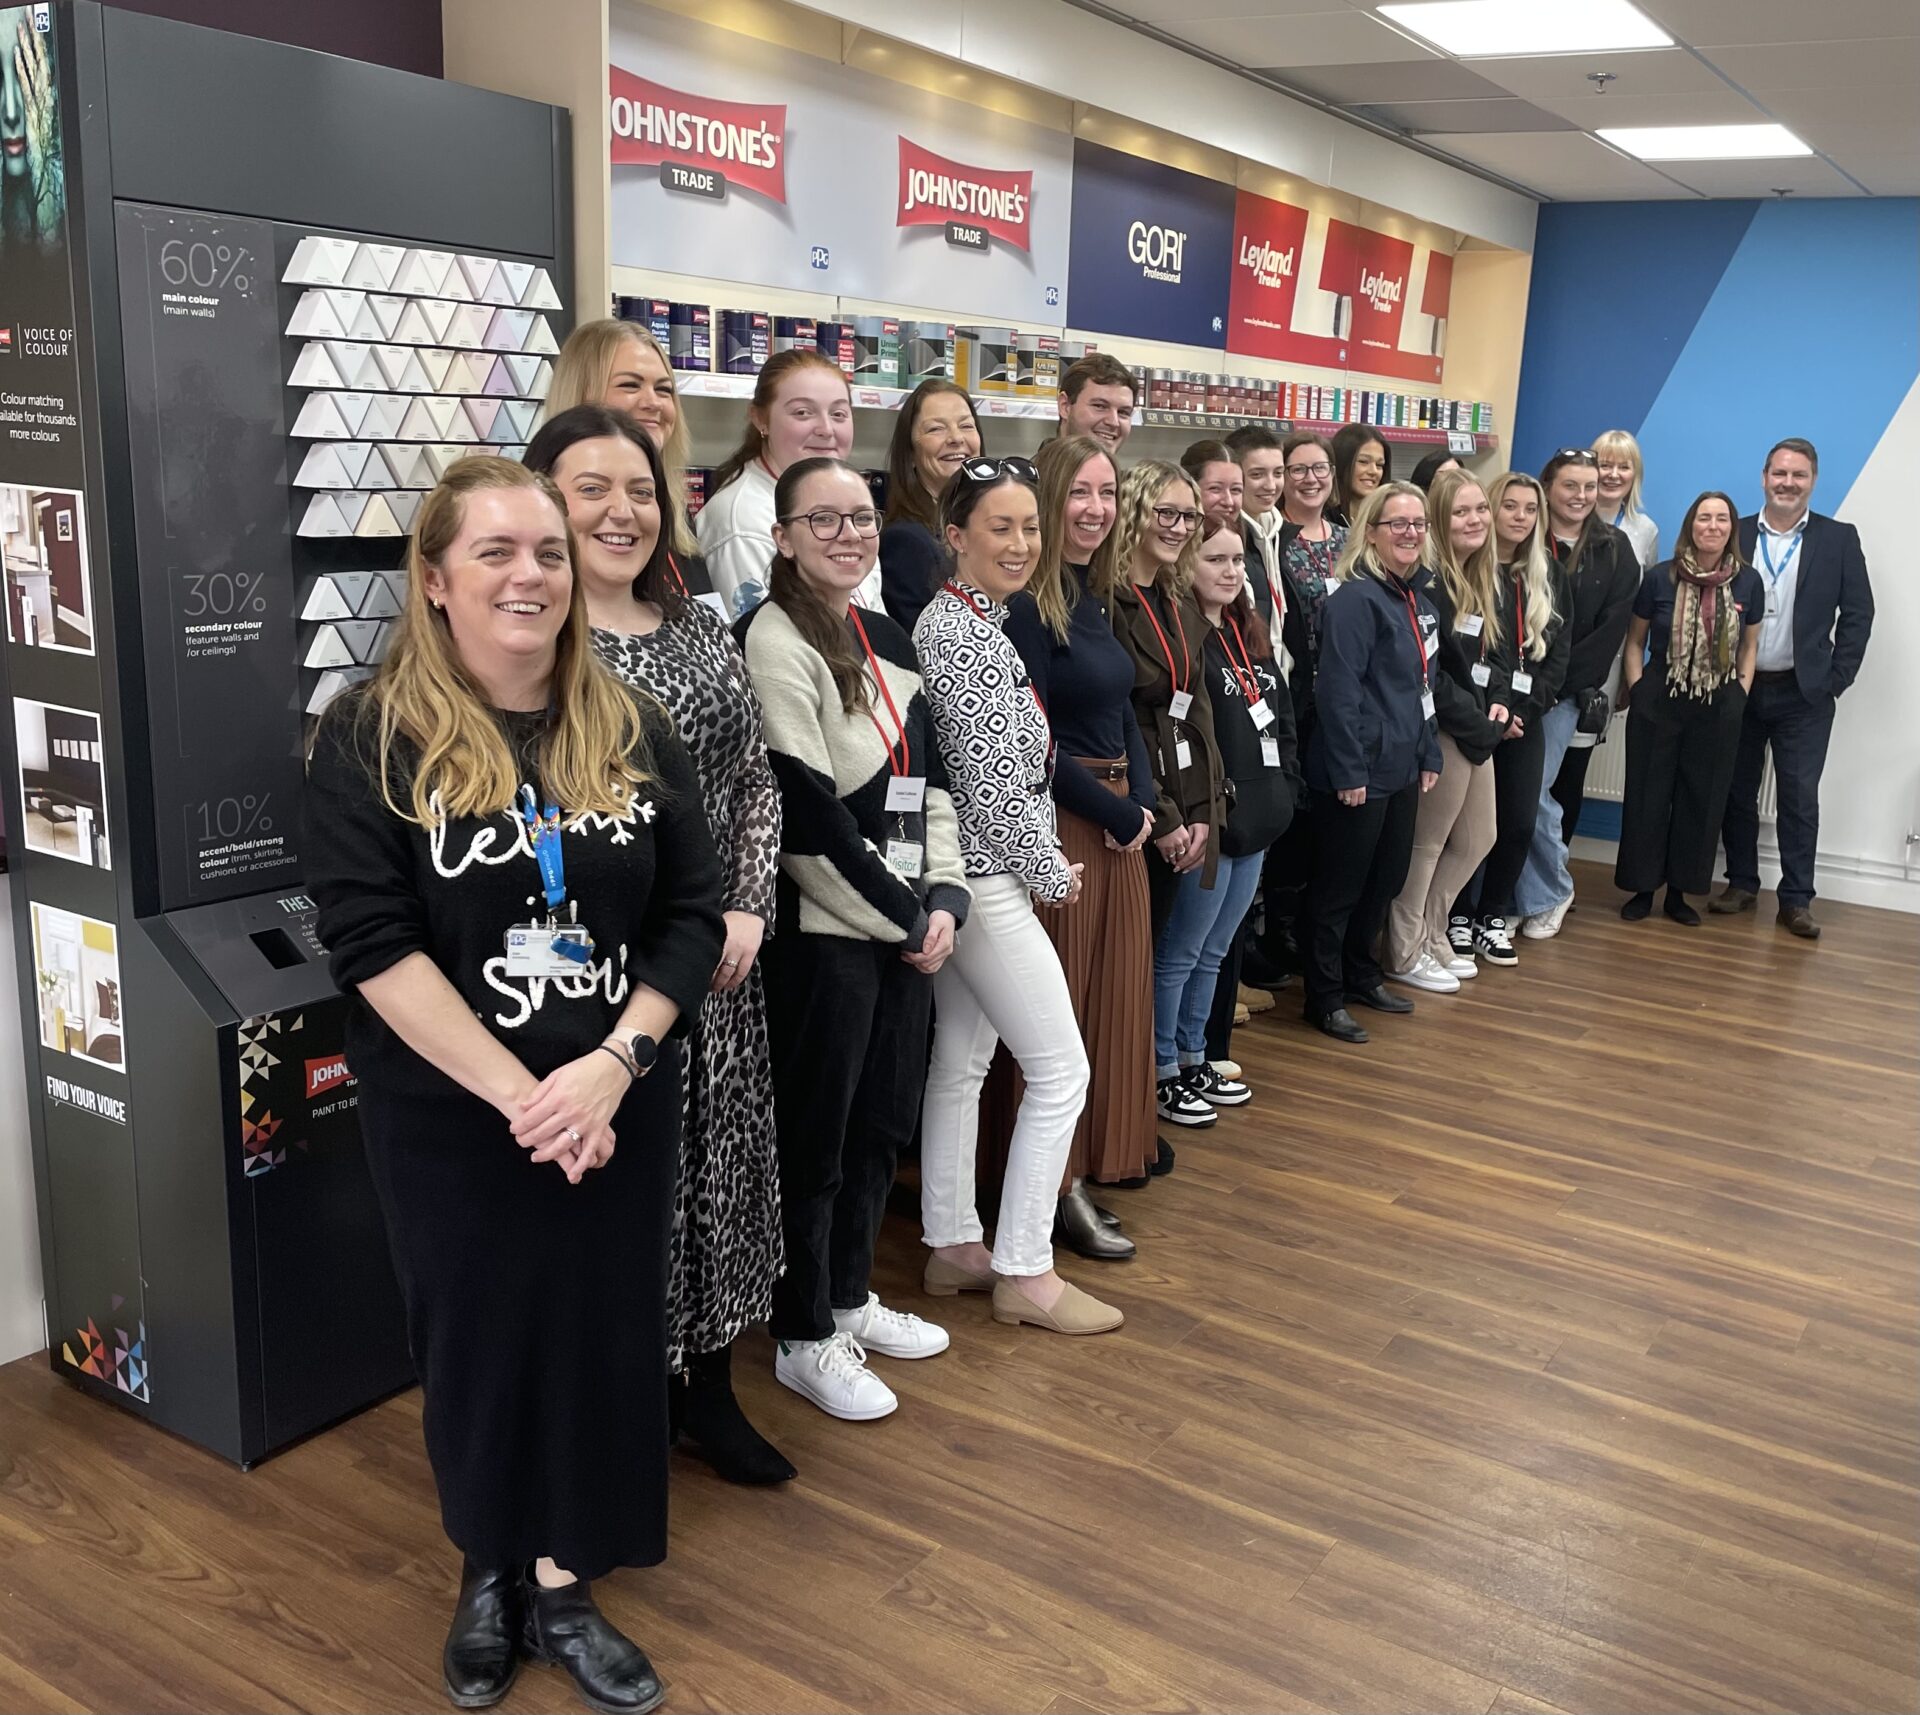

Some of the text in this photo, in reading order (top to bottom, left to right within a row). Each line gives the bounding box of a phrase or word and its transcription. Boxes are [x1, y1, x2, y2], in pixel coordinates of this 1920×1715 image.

[611, 97, 777, 168] OHNSTONE'S
[672, 168, 714, 191] TRADE
[905, 168, 1024, 224] JOHNSTONE'S
[953, 226, 981, 244] TRADE
[1128, 221, 1183, 271] GORI
[1239, 235, 1294, 276] Leyland
[161, 240, 249, 291] 60%
[812, 248, 829, 268] PPG
[1143, 265, 1181, 284] Professional
[1258, 270, 1282, 289] Trade
[1360, 267, 1402, 303] Leyland
[162, 293, 219, 306] main colour
[1373, 298, 1392, 314] Trade
[163, 304, 216, 318] (main walls)
[24, 328, 56, 341] VOICE
[59, 329, 73, 341] OF
[25, 343, 68, 356] COLOUR
[0, 392, 64, 410] Colour matching
[24, 411, 36, 422] for
[37, 412, 77, 426] thousands
[10, 429, 60, 442] more colours
[183, 572, 266, 616] 30%
[185, 621, 263, 633] secondary colour
[185, 632, 259, 646] (feature walls and
[186, 645, 237, 658] /or ceilings)
[198, 792, 272, 842] 10%
[199, 836, 284, 858] accent/bold/strong
[199, 847, 284, 869] colour (trim, skirting,
[200, 854, 298, 880] cushions or accessories)
[276, 896, 309, 913] THE
[46, 1075, 126, 1122] FIND YOUR VOICE
[312, 1103, 336, 1119] PAINT
[337, 1099, 348, 1110] TO
